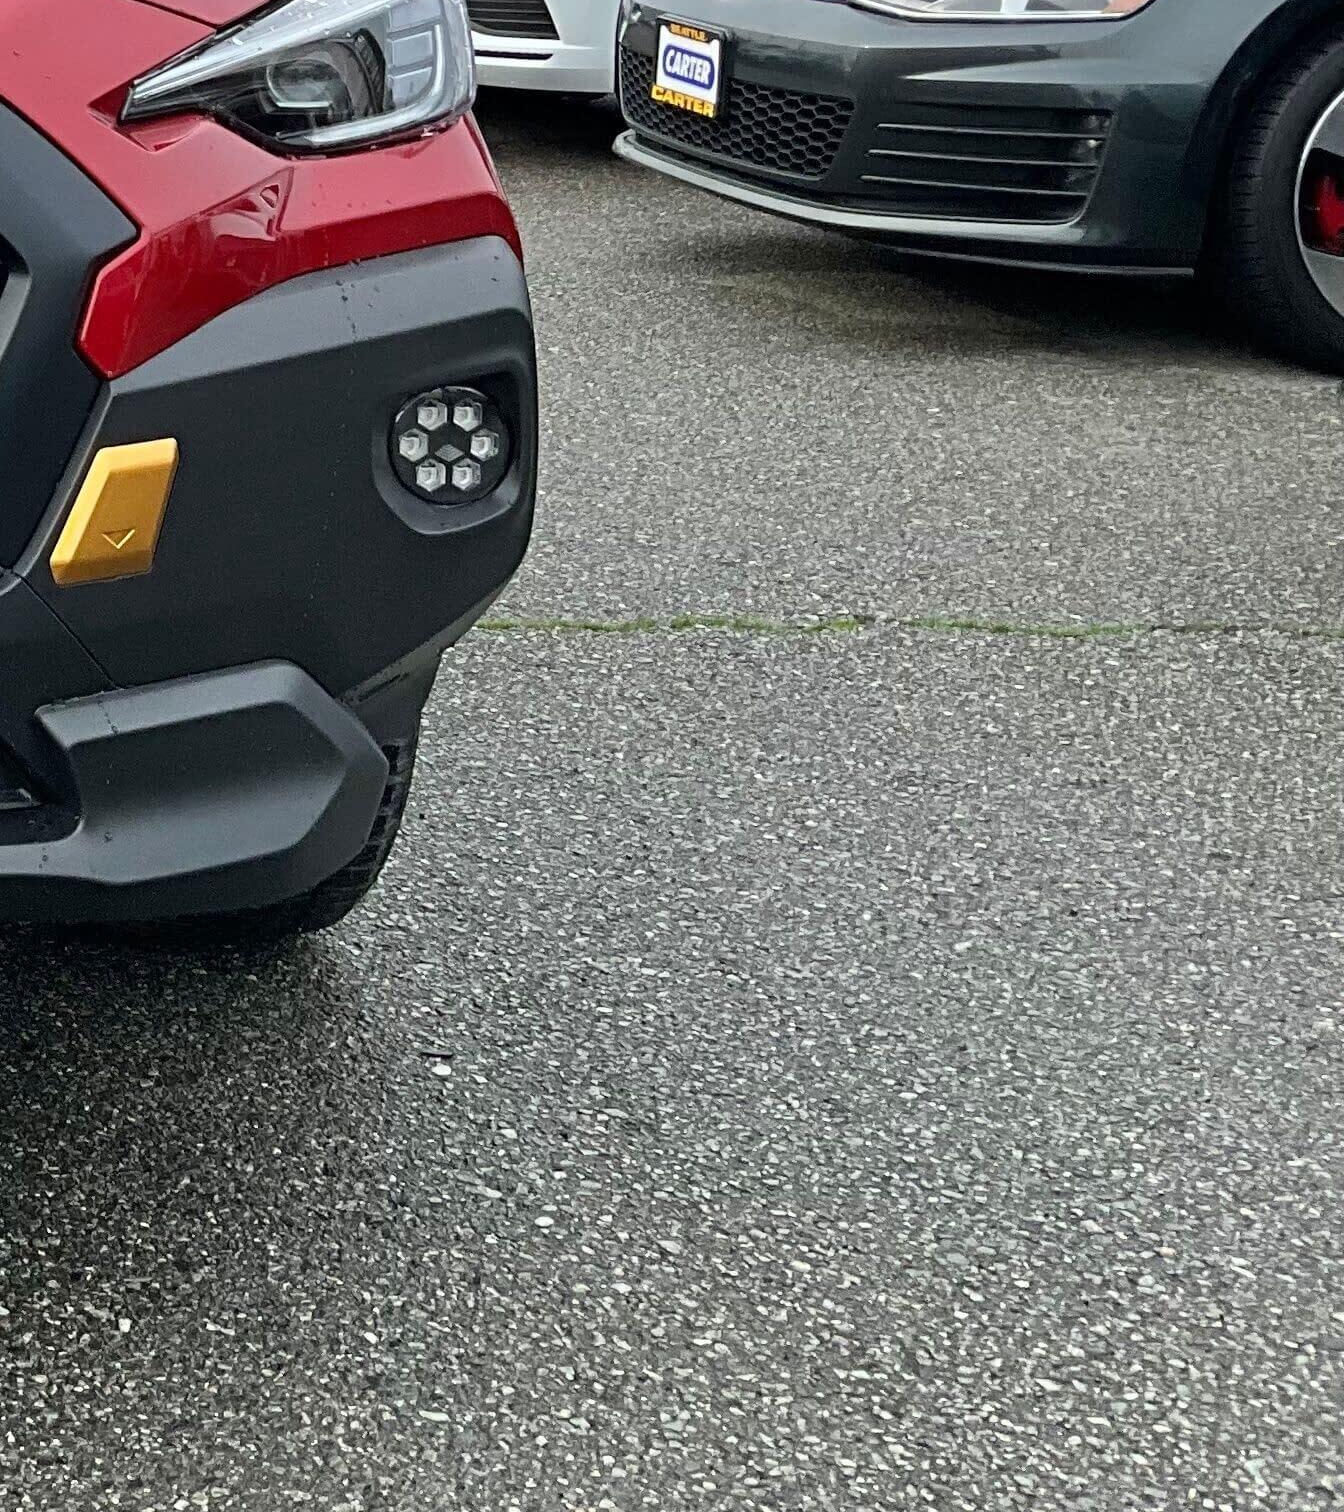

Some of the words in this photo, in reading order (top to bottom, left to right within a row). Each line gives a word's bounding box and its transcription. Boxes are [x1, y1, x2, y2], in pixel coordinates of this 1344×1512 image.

[670, 23, 706, 41] SEATTLE
[665, 48, 712, 85] CARTER
[651, 85, 716, 118] CARTER
